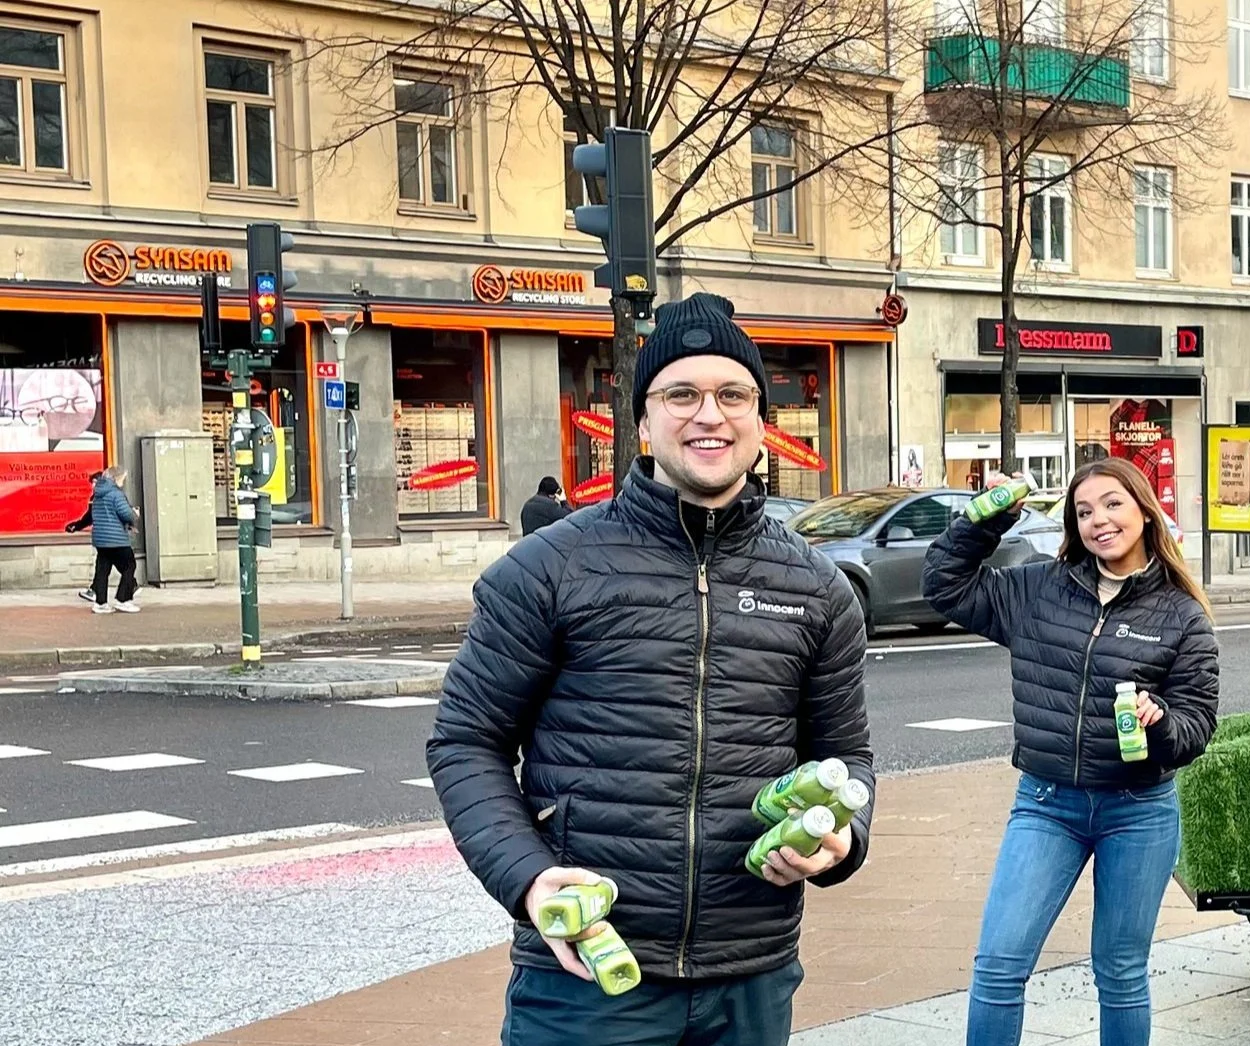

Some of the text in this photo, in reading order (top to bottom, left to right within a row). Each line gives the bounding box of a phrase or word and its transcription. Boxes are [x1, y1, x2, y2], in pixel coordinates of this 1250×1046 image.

[135, 246, 232, 272] SYNSAM
[136, 273, 231, 288] RECYCLING SRE
[512, 269, 585, 292] SYNSAM
[512, 292, 586, 305] RECYCLING STORE
[1179, 330, 1198, 352] D
[327, 386, 343, 402] TAXI
[1119, 421, 1161, 431] FLANELL-
[1115, 432, 1162, 442] SKJORTOR
[9, 462, 76, 472] Välkommen till
[25, 473, 66, 483] Recycling
[68, 472, 88, 480] Outl
[757, 601, 805, 616] innocent
